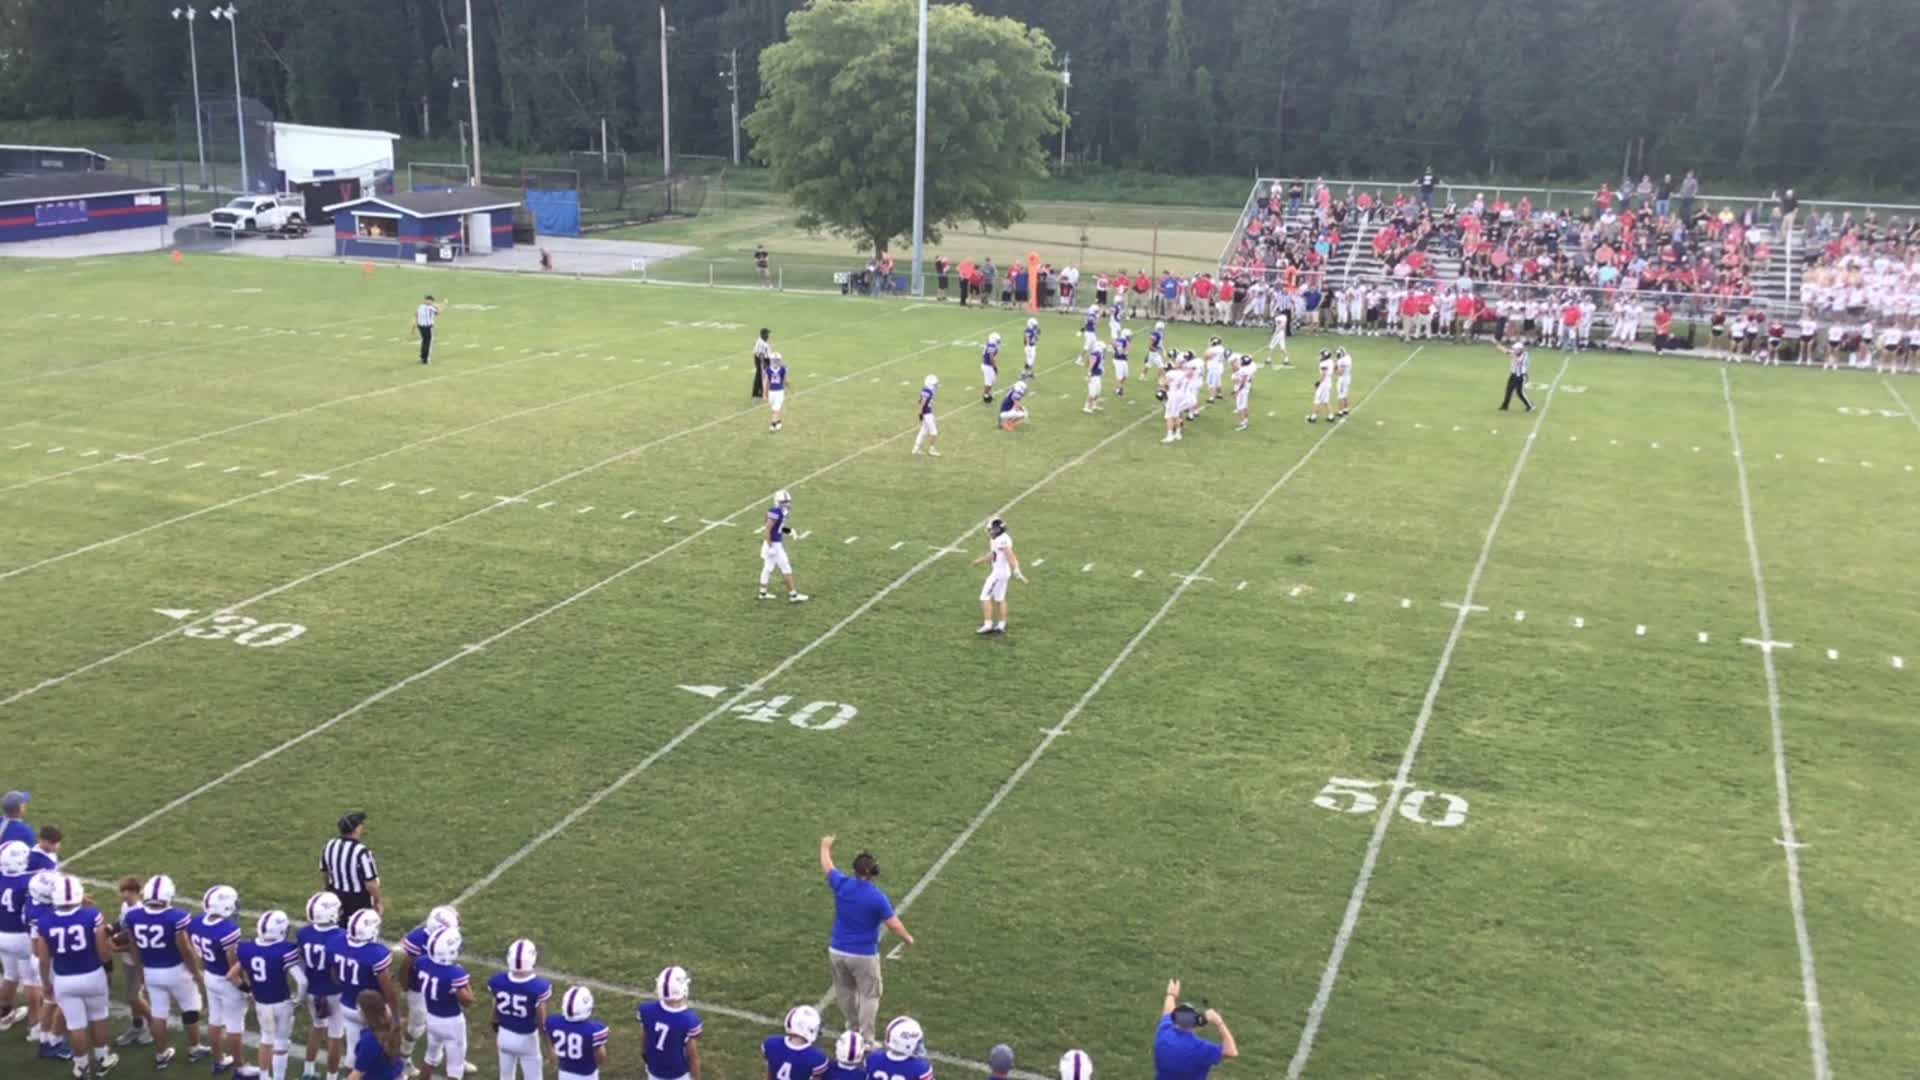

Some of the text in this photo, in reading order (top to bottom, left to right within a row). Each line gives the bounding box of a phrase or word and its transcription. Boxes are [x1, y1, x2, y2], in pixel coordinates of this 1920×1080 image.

[183, 615, 307, 648] 30
[730, 695, 859, 730] 40
[1312, 776, 1470, 827] 50
[1, 887, 16, 913] 4
[49, 924, 87, 954] 73
[134, 923, 167, 949] 52
[250, 956, 267, 982] 9
[303, 942, 326, 971] 17
[334, 953, 359, 985] 77
[418, 970, 439, 1000] 71
[496, 991, 528, 1018] 25
[552, 1029, 583, 1060] 28
[654, 1021, 669, 1052] 7
[776, 1061, 792, 1080] 4
